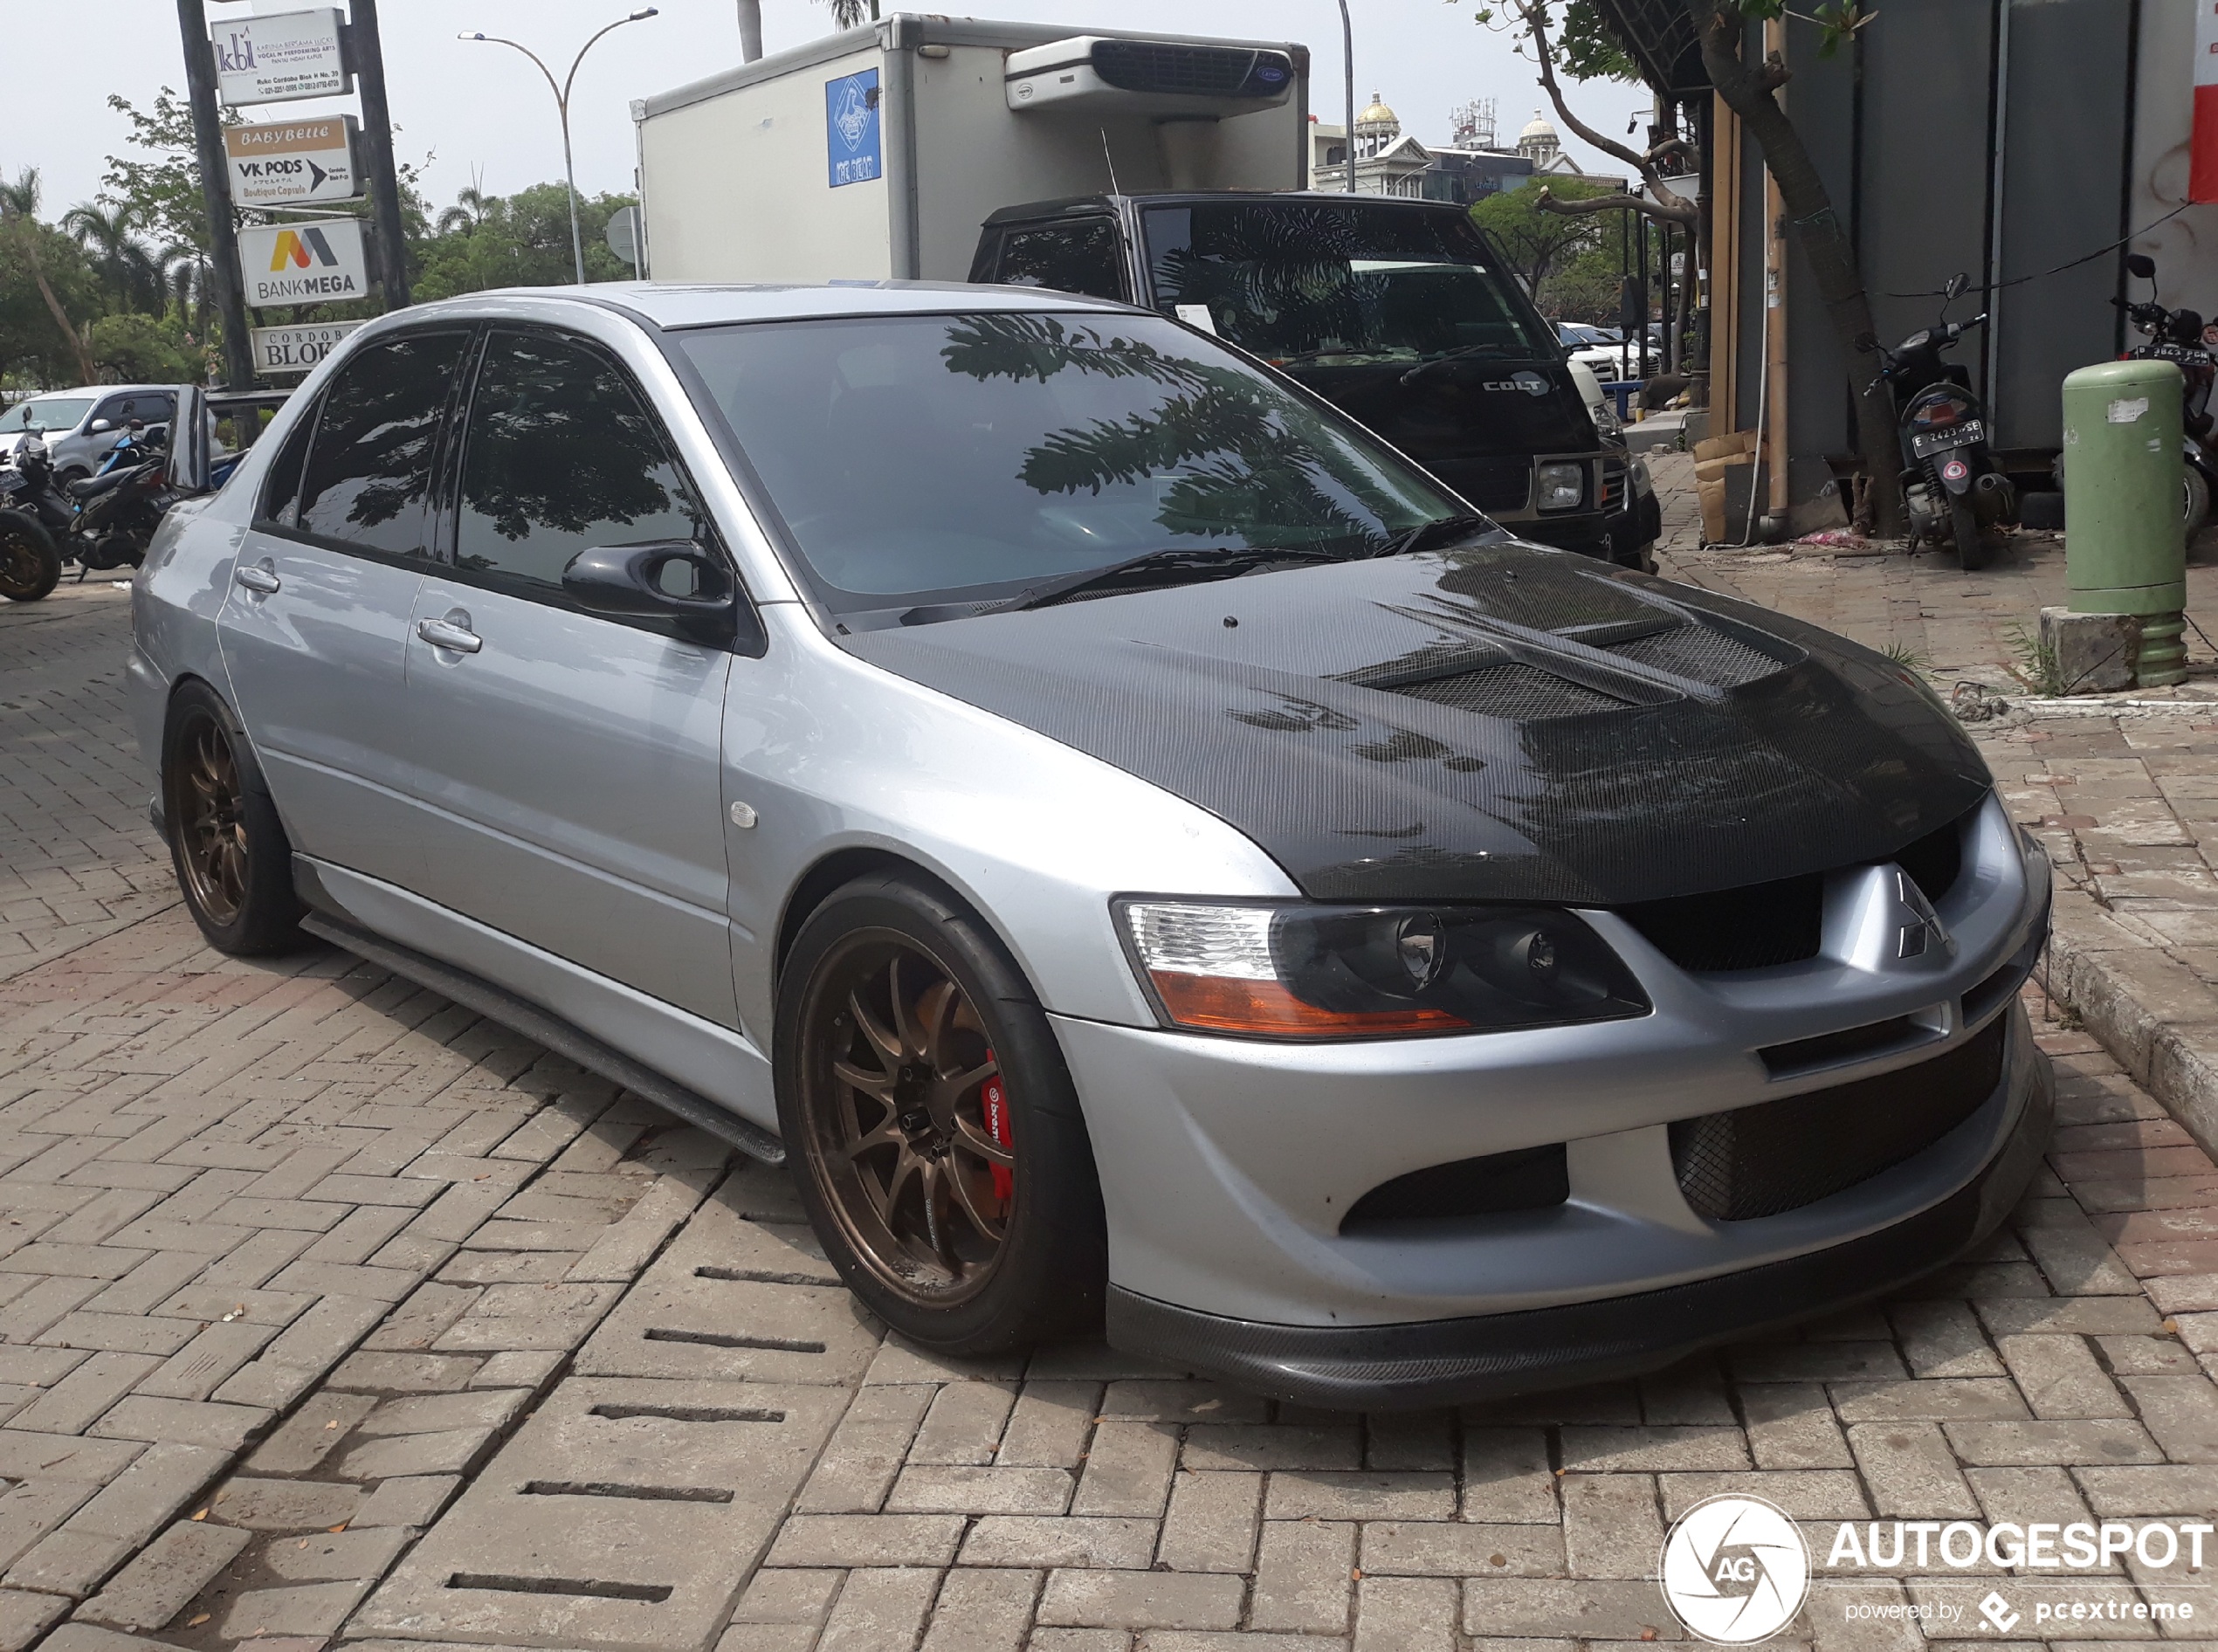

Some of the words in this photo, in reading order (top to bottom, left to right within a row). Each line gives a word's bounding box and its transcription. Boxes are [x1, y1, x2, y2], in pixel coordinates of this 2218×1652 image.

[284, 47, 320, 56] PERFORMING
[241, 126, 329, 145] BABYBELLE
[238, 162, 264, 177] VK
[265, 160, 303, 176] PODS
[836, 160, 851, 184] ICE
[851, 155, 873, 182] BEAR
[244, 187, 277, 198] Boutique
[278, 184, 307, 196] Capsule
[269, 330, 352, 343] CORDOB
[1482, 381, 1540, 391] COLT
[1915, 437, 1922, 446] E
[1930, 428, 1957, 441] 2423
